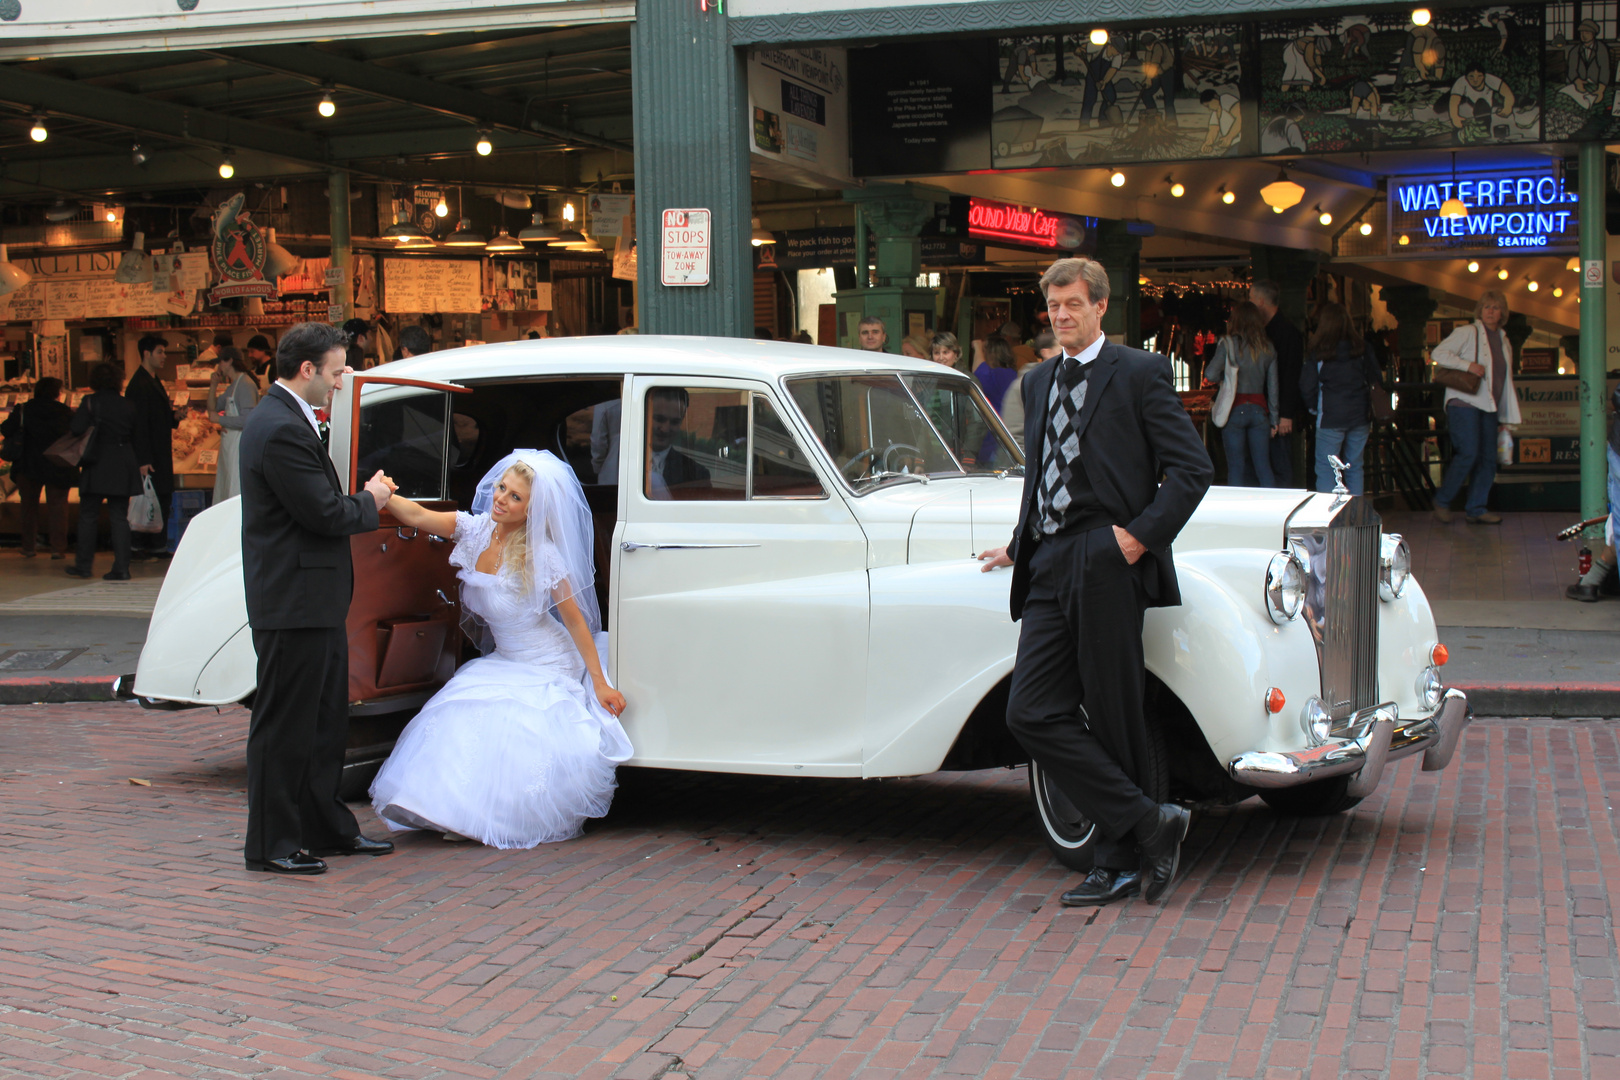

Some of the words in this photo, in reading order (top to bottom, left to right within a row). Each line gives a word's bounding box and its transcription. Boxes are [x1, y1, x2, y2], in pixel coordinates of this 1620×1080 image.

[789, 85, 799, 101] ALL
[791, 100, 817, 121] LAVENDER
[1399, 176, 1579, 213] WATERFRO
[666, 211, 686, 226] NO
[1424, 210, 1572, 238] VIEWPOINT
[667, 230, 704, 244] STOPS
[787, 239, 799, 247] We
[799, 238, 816, 247] pack
[817, 235, 831, 245] fish
[841, 236, 852, 246] go
[1497, 235, 1548, 247] SEATING
[666, 250, 705, 260] TOW-AWAY
[802, 250, 816, 258] your
[816, 248, 832, 256] order
[220, 261, 240, 280] PLACE
[241, 265, 258, 279] FISH
[674, 261, 696, 271] ZONE
[214, 286, 241, 296] WORLD
[241, 284, 272, 294] FAMOUS
[1516, 385, 1580, 402] Mezzani
[1531, 411, 1546, 419] Pike
[1548, 411, 1567, 419] Place
